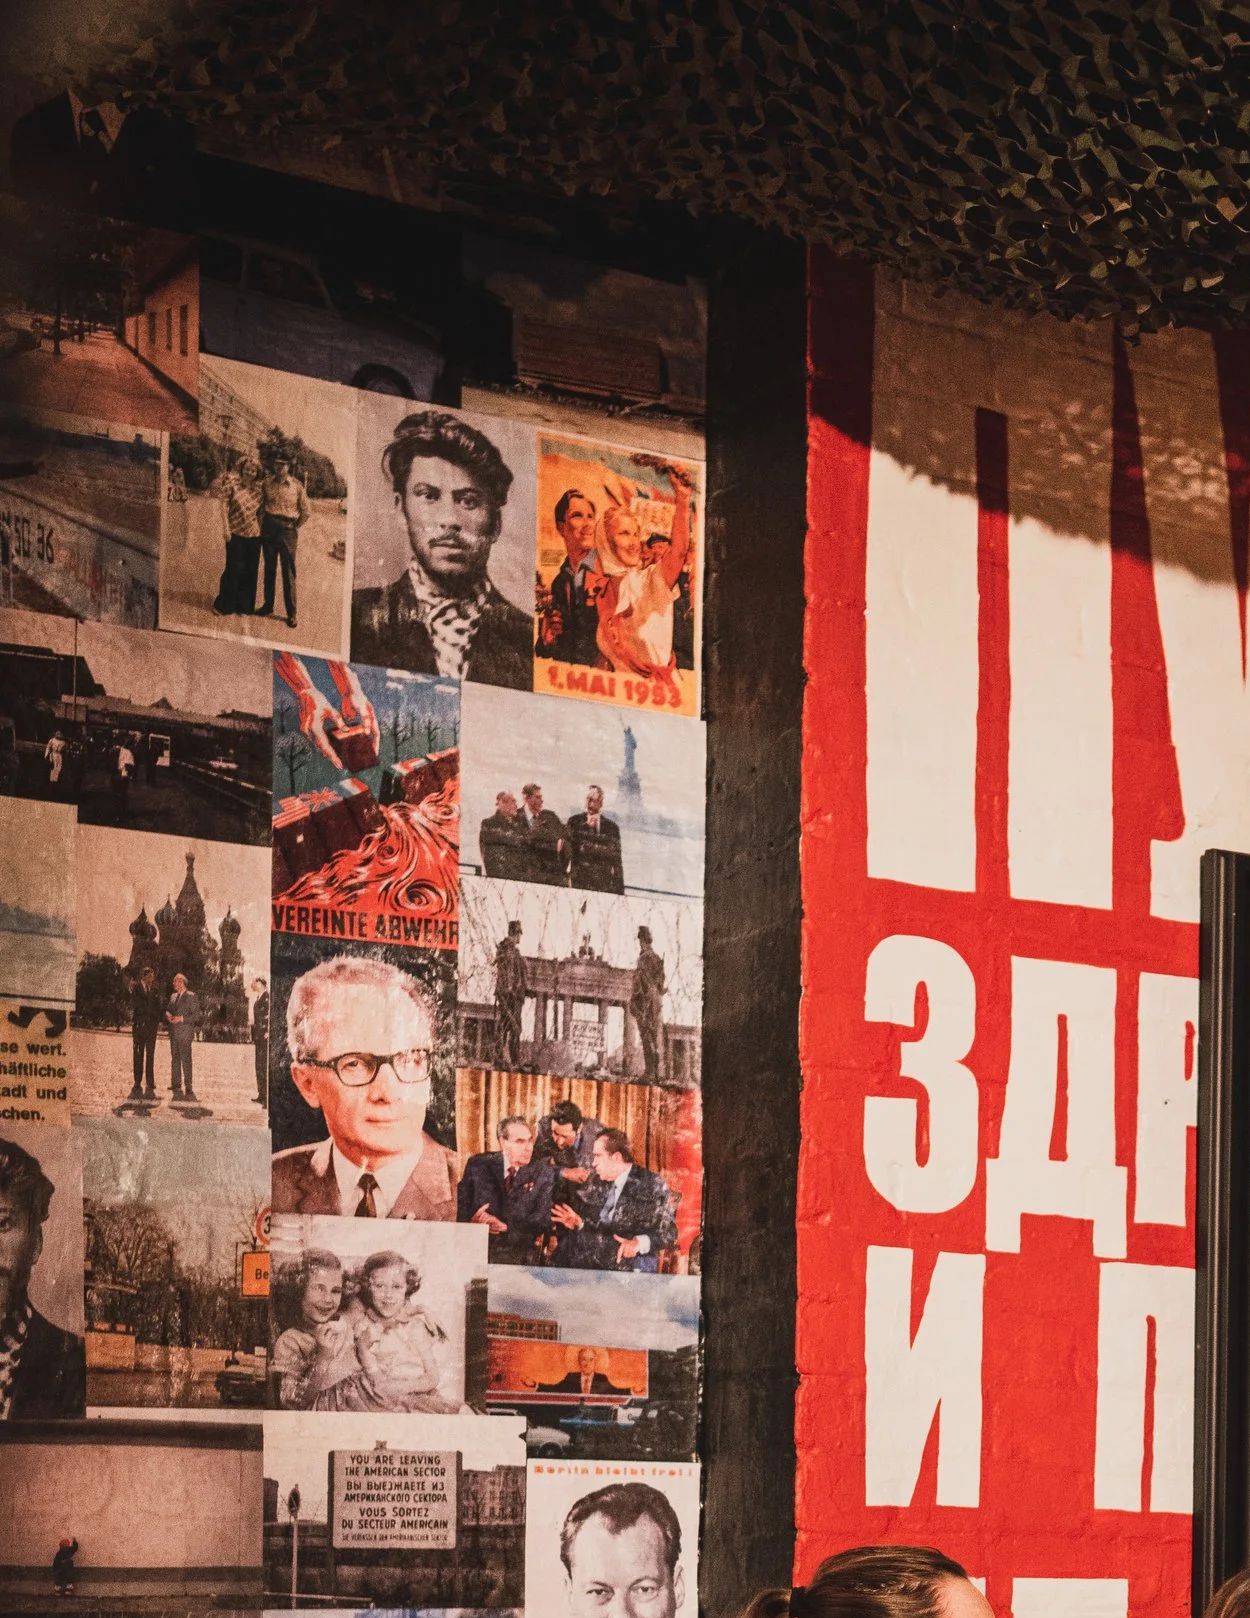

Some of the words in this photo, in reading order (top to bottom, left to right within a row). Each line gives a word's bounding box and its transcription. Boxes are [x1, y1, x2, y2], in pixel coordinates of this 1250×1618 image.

[272, 904, 368, 938] VEREINTE
[375, 914, 459, 946] ABWEHR
[26, 1043, 67, 1056] wert.
[36, 1087, 67, 1101] und
[0, 1106, 45, 1121] chen.
[255, 1268, 269, 1280] Be
[865, 1245, 986, 1508] И
[350, 1455, 369, 1465] YOU
[375, 1455, 393, 1465] ARE
[400, 1455, 441, 1466] LEAVING
[345, 1467, 359, 1476] THE
[364, 1467, 408, 1476] AMERICAN
[414, 1467, 446, 1476] SECTOR
[347, 1482, 361, 1491] ВЫ
[367, 1482, 425, 1491] ВЫЕЗЖАЕТЕ
[432, 1482, 444, 1491] ИЗ
[344, 1493, 410, 1502] АМЕРИКАНСКОГО
[413, 1493, 448, 1503] СЕКТОРА
[360, 1507, 387, 1518] VOUS
[392, 1507, 429, 1518] SORTEZ
[342, 1520, 353, 1529] DU
[358, 1520, 396, 1529] SECTEUR
[401, 1520, 448, 1529] AMERICAIN
